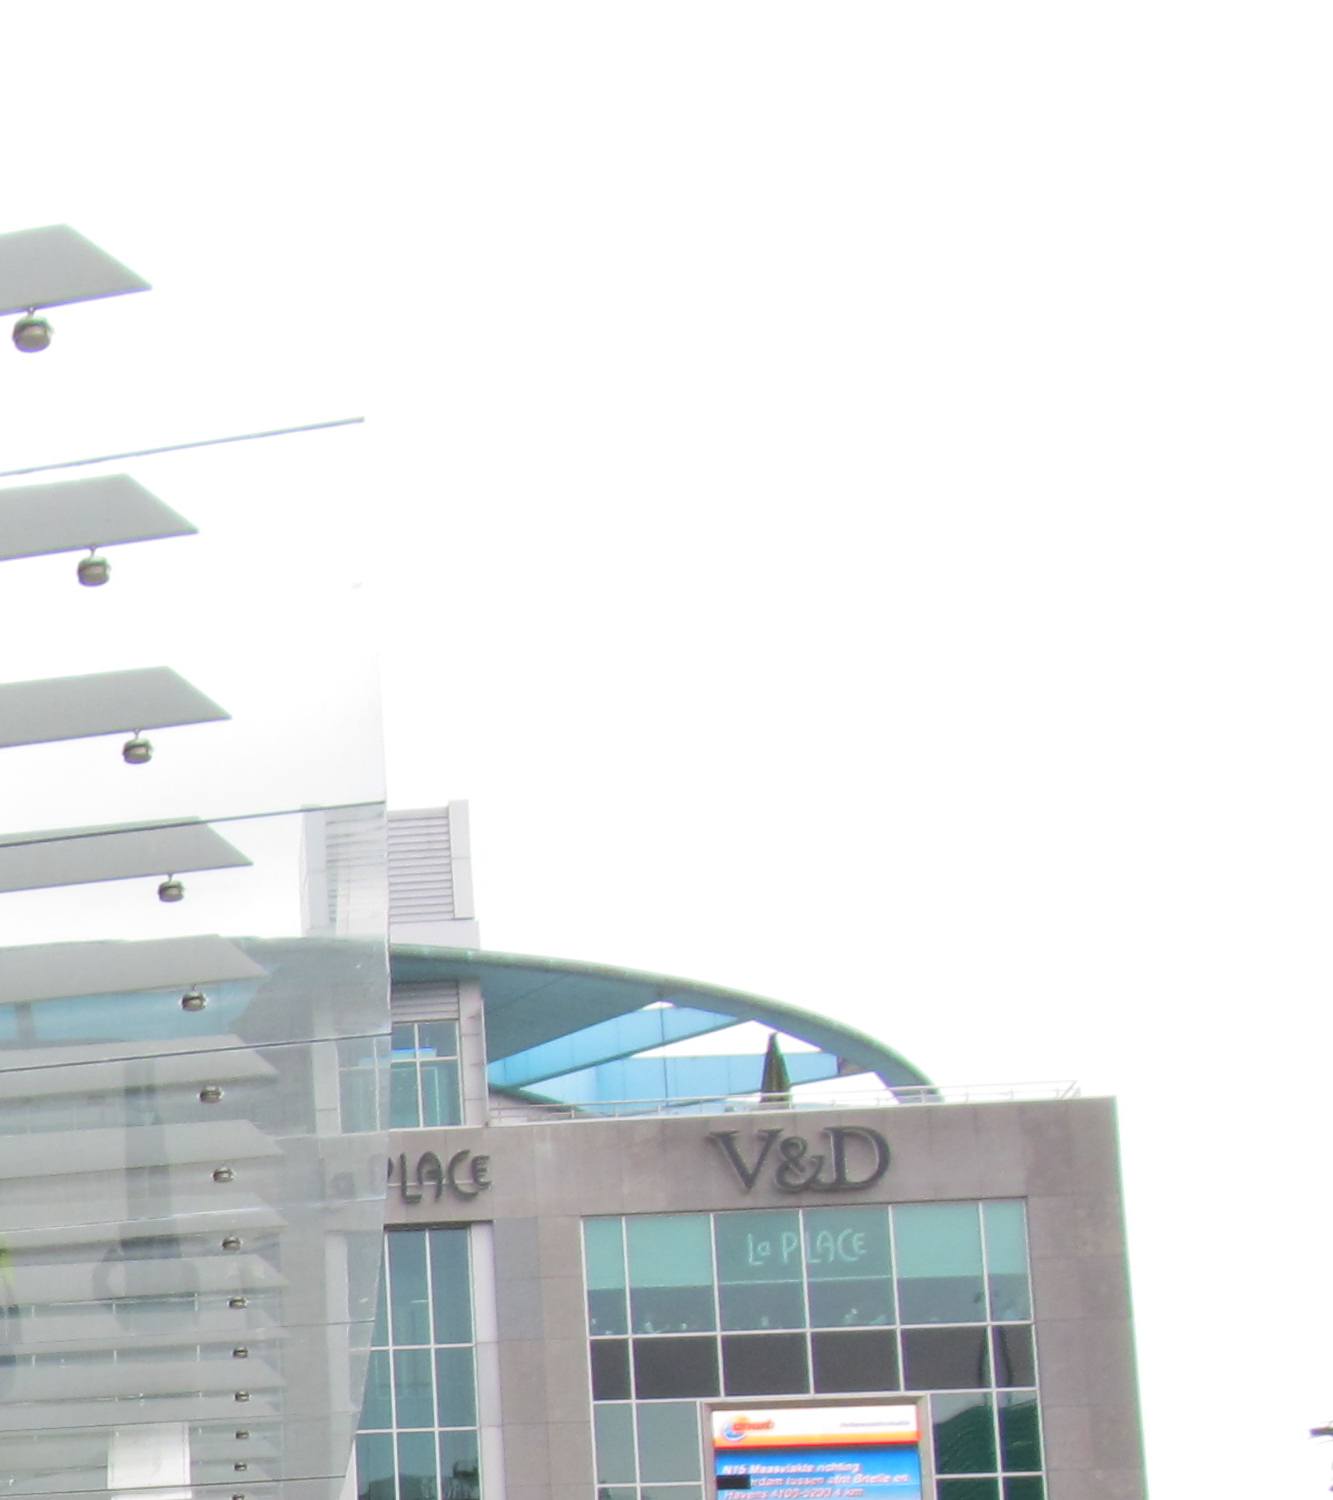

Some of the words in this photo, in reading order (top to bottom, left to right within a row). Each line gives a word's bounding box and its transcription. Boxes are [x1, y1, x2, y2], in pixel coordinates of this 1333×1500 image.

[709, 1126, 890, 1194] V&D
[748, 1232, 772, 1265] La
[781, 1229, 867, 1264] PLACE
